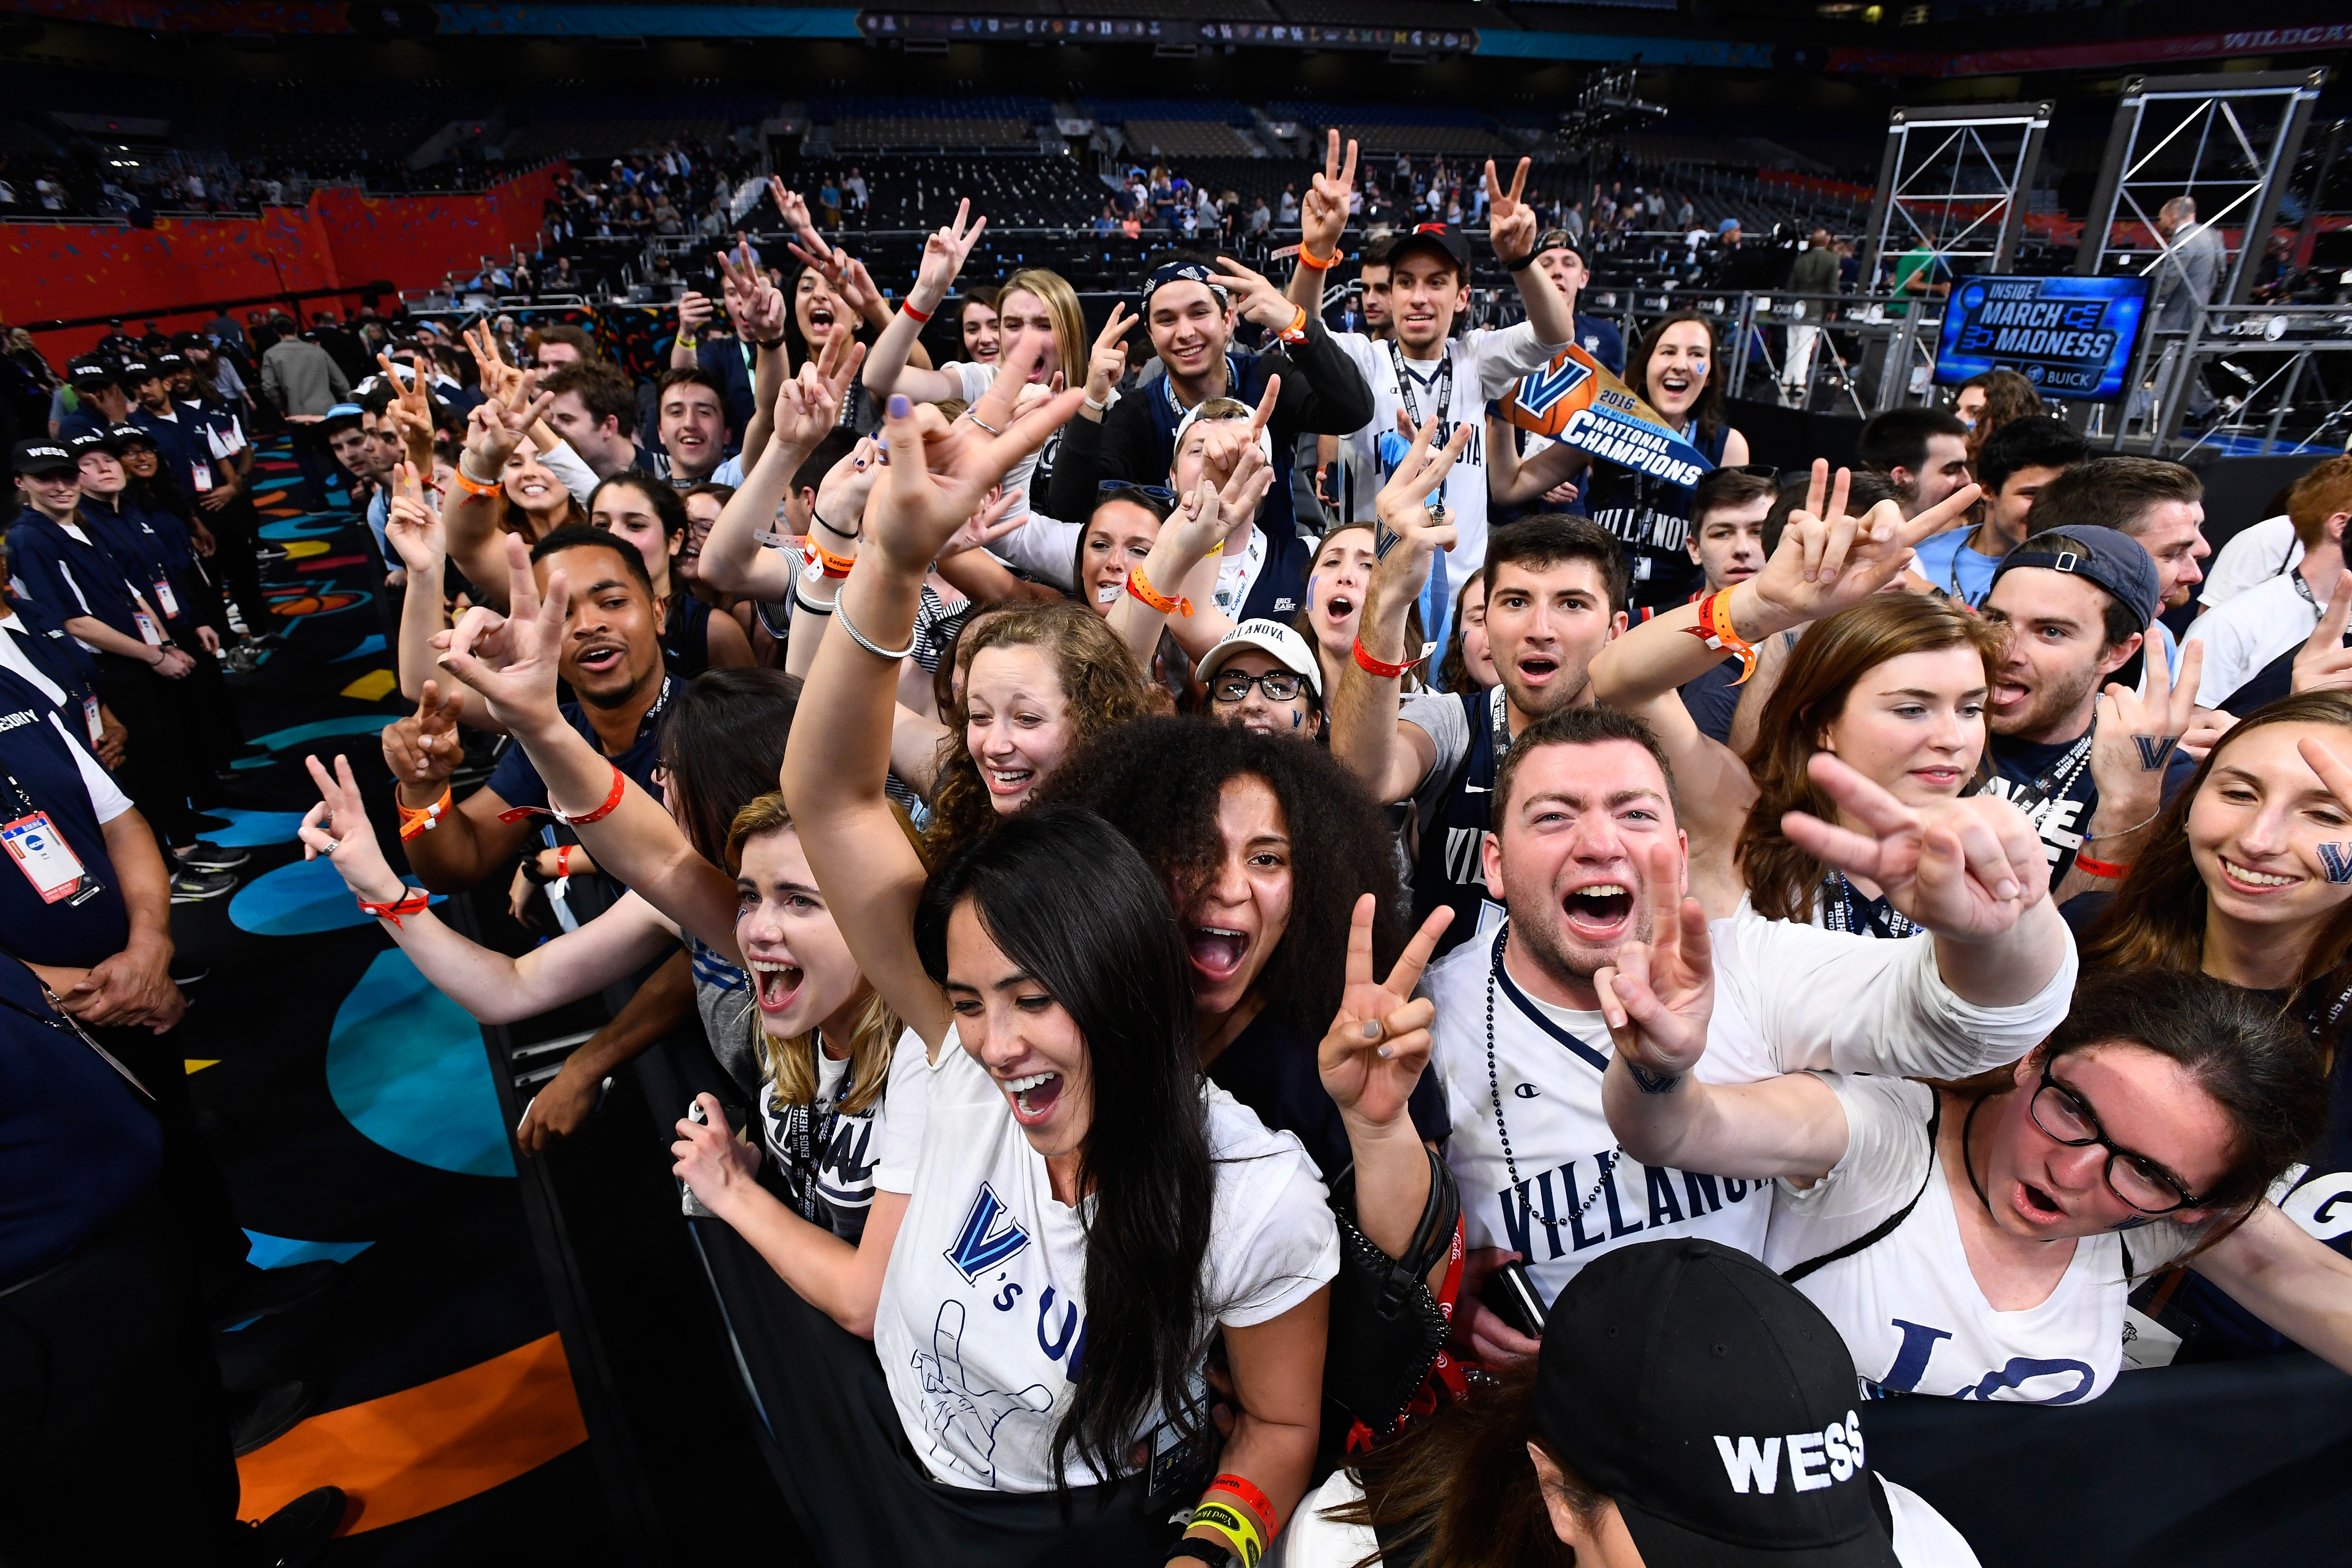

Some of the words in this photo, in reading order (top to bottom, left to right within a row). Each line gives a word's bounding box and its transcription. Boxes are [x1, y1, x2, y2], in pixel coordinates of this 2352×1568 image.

[2223, 24, 2352, 49] WILDCA
[1989, 283, 2036, 300] INSIDE
[1979, 301, 2065, 328] MARCH
[1994, 327, 2112, 359] MADNESS
[2047, 370, 2091, 387] BUICK
[1598, 389, 1636, 411] 2016
[1560, 409, 1703, 486] CHAMPIONS
[1592, 417, 1671, 455] NATIONAL
[26, 447, 69, 457] WESS
[918, 610, 931, 629] HERE
[2055, 754, 2070, 768] THE
[2070, 737, 2086, 756] ROAD
[2054, 757, 2075, 780] ENDS
[1834, 901, 1847, 931] HERE
[800, 1135, 810, 1158] ENDS
[1037, 1283, 1088, 1386] U
[1713, 1409, 1866, 1494] WESS
[1211, 1511, 1231, 1526] Yard
